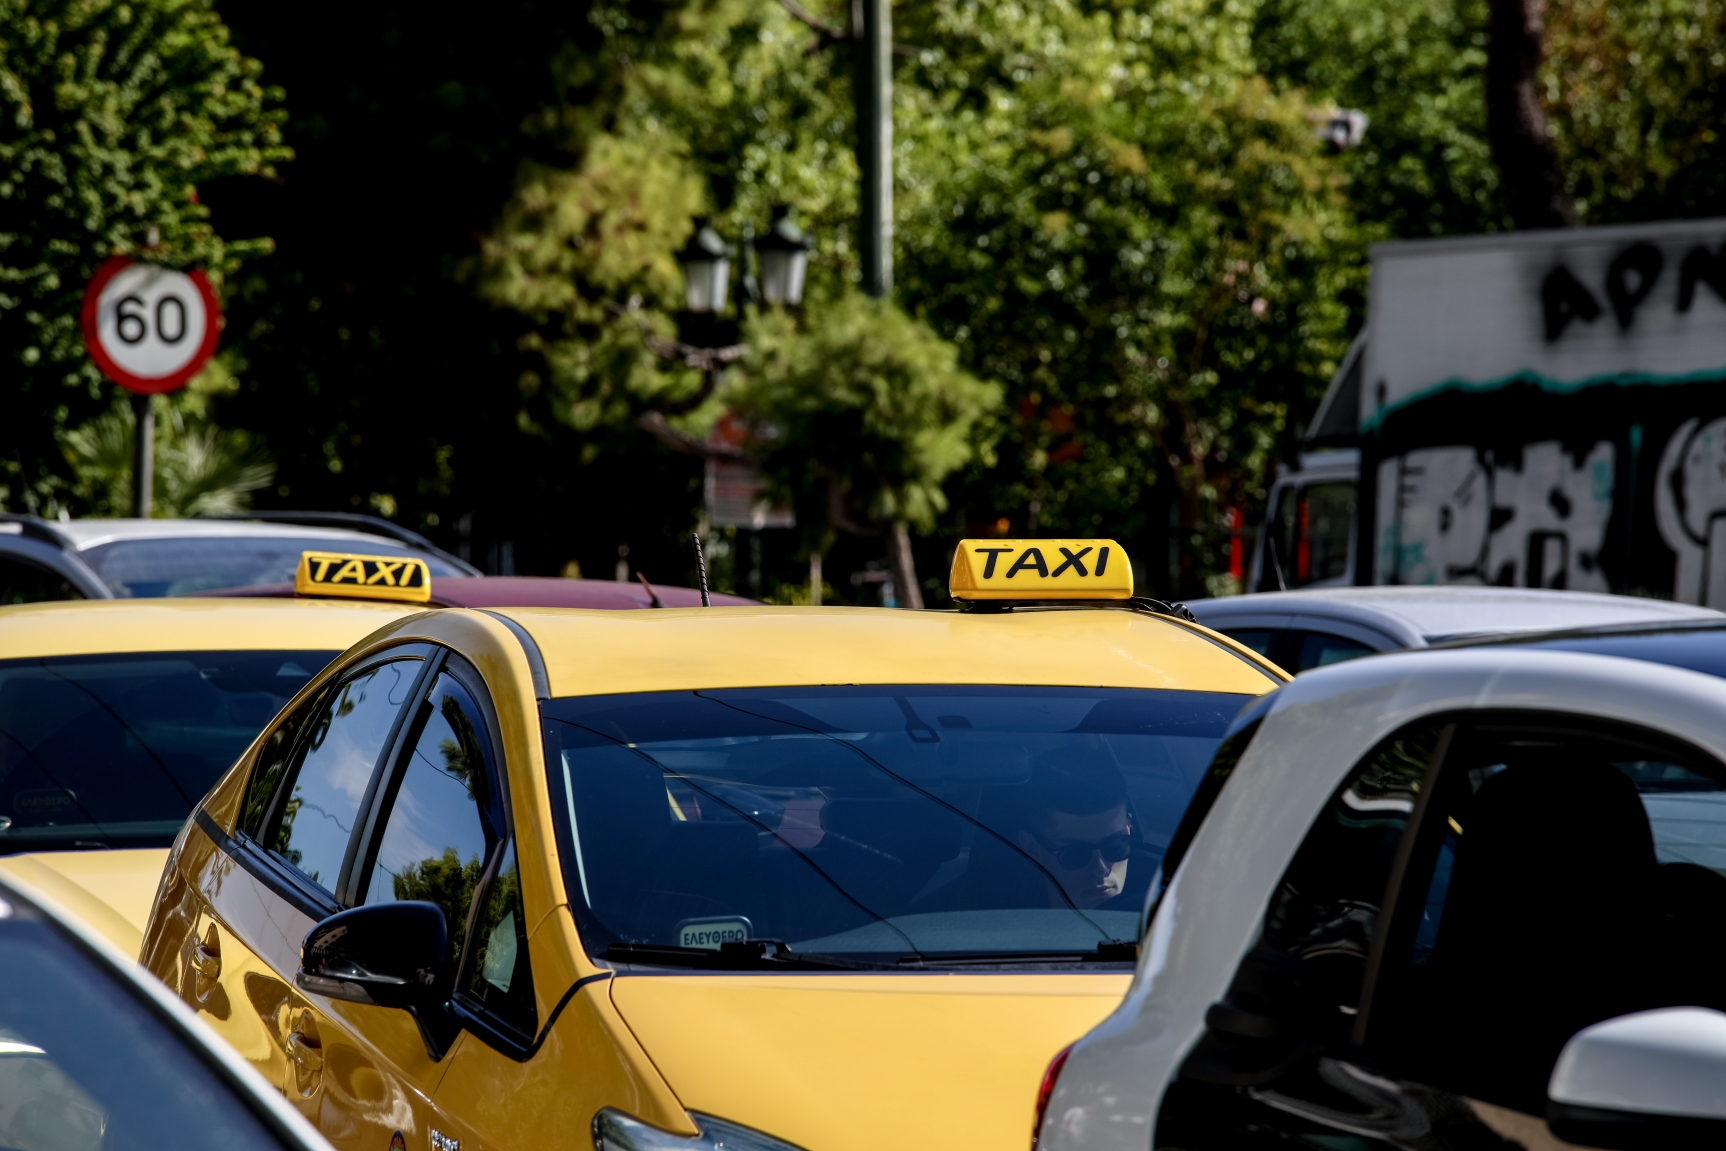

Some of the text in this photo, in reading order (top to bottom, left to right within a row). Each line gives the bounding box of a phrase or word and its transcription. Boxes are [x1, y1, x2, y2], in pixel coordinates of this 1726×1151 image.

[115, 294, 187, 345] 60
[310, 557, 416, 587] TAXI
[974, 546, 1110, 579] TAXI
